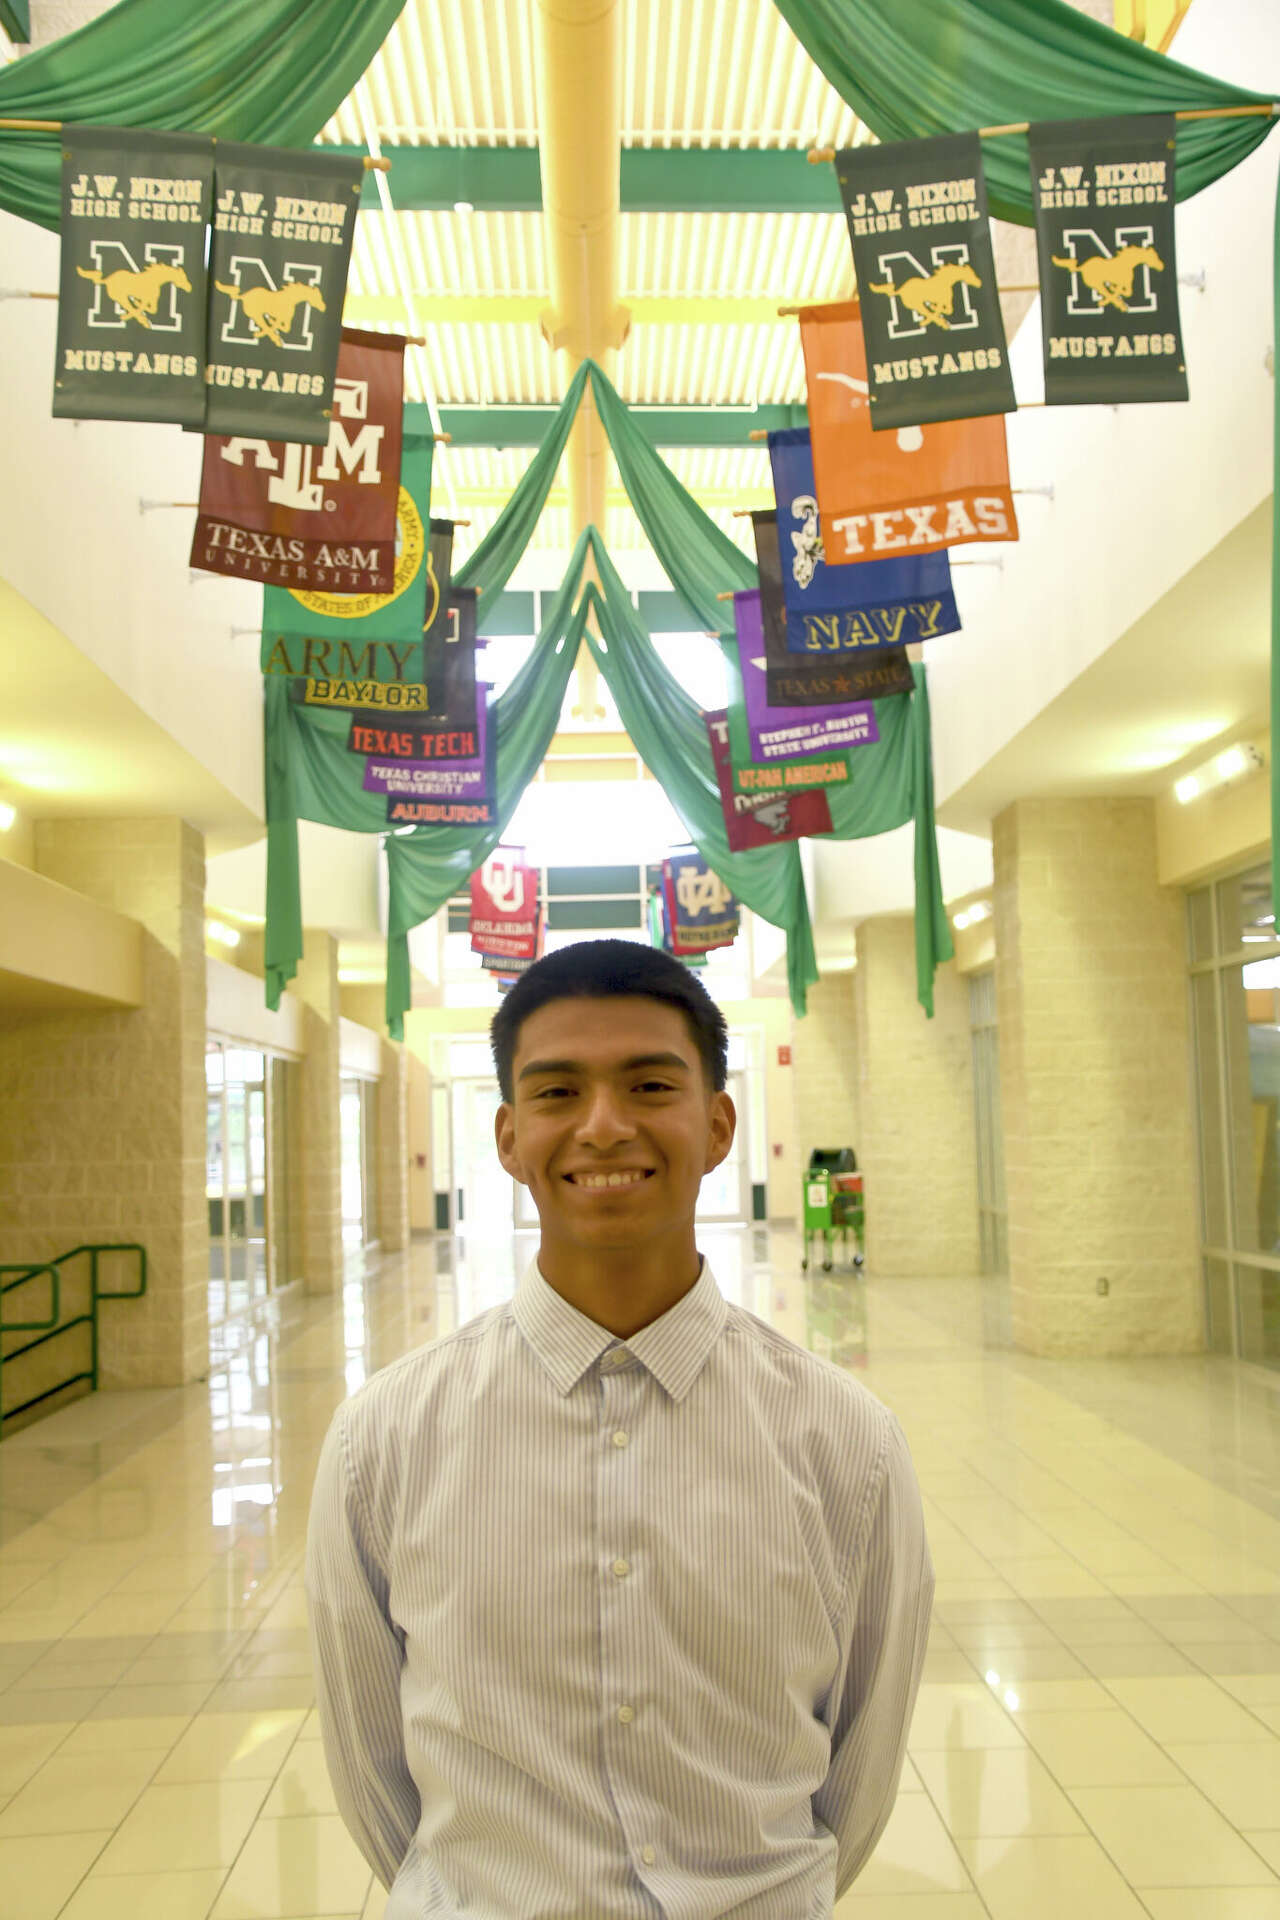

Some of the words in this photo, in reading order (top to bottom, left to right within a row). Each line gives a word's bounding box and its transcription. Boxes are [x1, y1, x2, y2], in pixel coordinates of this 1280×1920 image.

[71, 174, 124, 200] J.W.
[130, 177, 202, 204] NIXON
[1039, 166, 1090, 191] J.W.
[1095, 162, 1167, 188] NIXON
[71, 200, 121, 218] HIGH
[128, 201, 202, 223] SCHOOL
[216, 190, 268, 217] J.W.
[274, 196, 347, 226] NIXON
[851, 190, 903, 217] J.W.
[906, 179, 976, 209] NIXON
[1040, 190, 1089, 210] HIGH
[1096, 185, 1169, 206] SCHOOL
[215, 214, 264, 236] HIGH
[271, 220, 343, 245] SCHOOL
[853, 213, 903, 236] HIGH
[908, 203, 981, 227] SCHOOL
[88, 240, 184, 332] N
[1063, 226, 1157, 315] N
[221, 256, 322, 351] N
[878, 244, 979, 339] N
[1050, 334, 1177, 359] MUSTANGS
[64, 349, 198, 376] MUSTANGS
[873, 348, 1002, 384] MUSTANGS
[832, 497, 1009, 555] TEXAS
[207, 522, 305, 561] TEXAS
[314, 544, 381, 571] A&M
[205, 549, 381, 587] UNIVERSITY
[803, 599, 944, 650] NAVY
[264, 636, 417, 682] ARMY
[311, 678, 421, 705] BAYLOR
[775, 676, 831, 699] TEXAS
[353, 726, 412, 756] TEXAS
[422, 731, 474, 757] TECH
[758, 725, 811, 744] STEPHEN
[763, 741, 802, 757] STATE
[801, 726, 869, 751] UNIVERSITY
[371, 765, 411, 782] TEXAS
[412, 769, 481, 783] CHRISTIAN
[386, 779, 463, 795] UNIVERSITY
[738, 768, 783, 788] UT-PAN
[784, 761, 848, 786] AMERICAN
[391, 802, 489, 822] AUBURN
